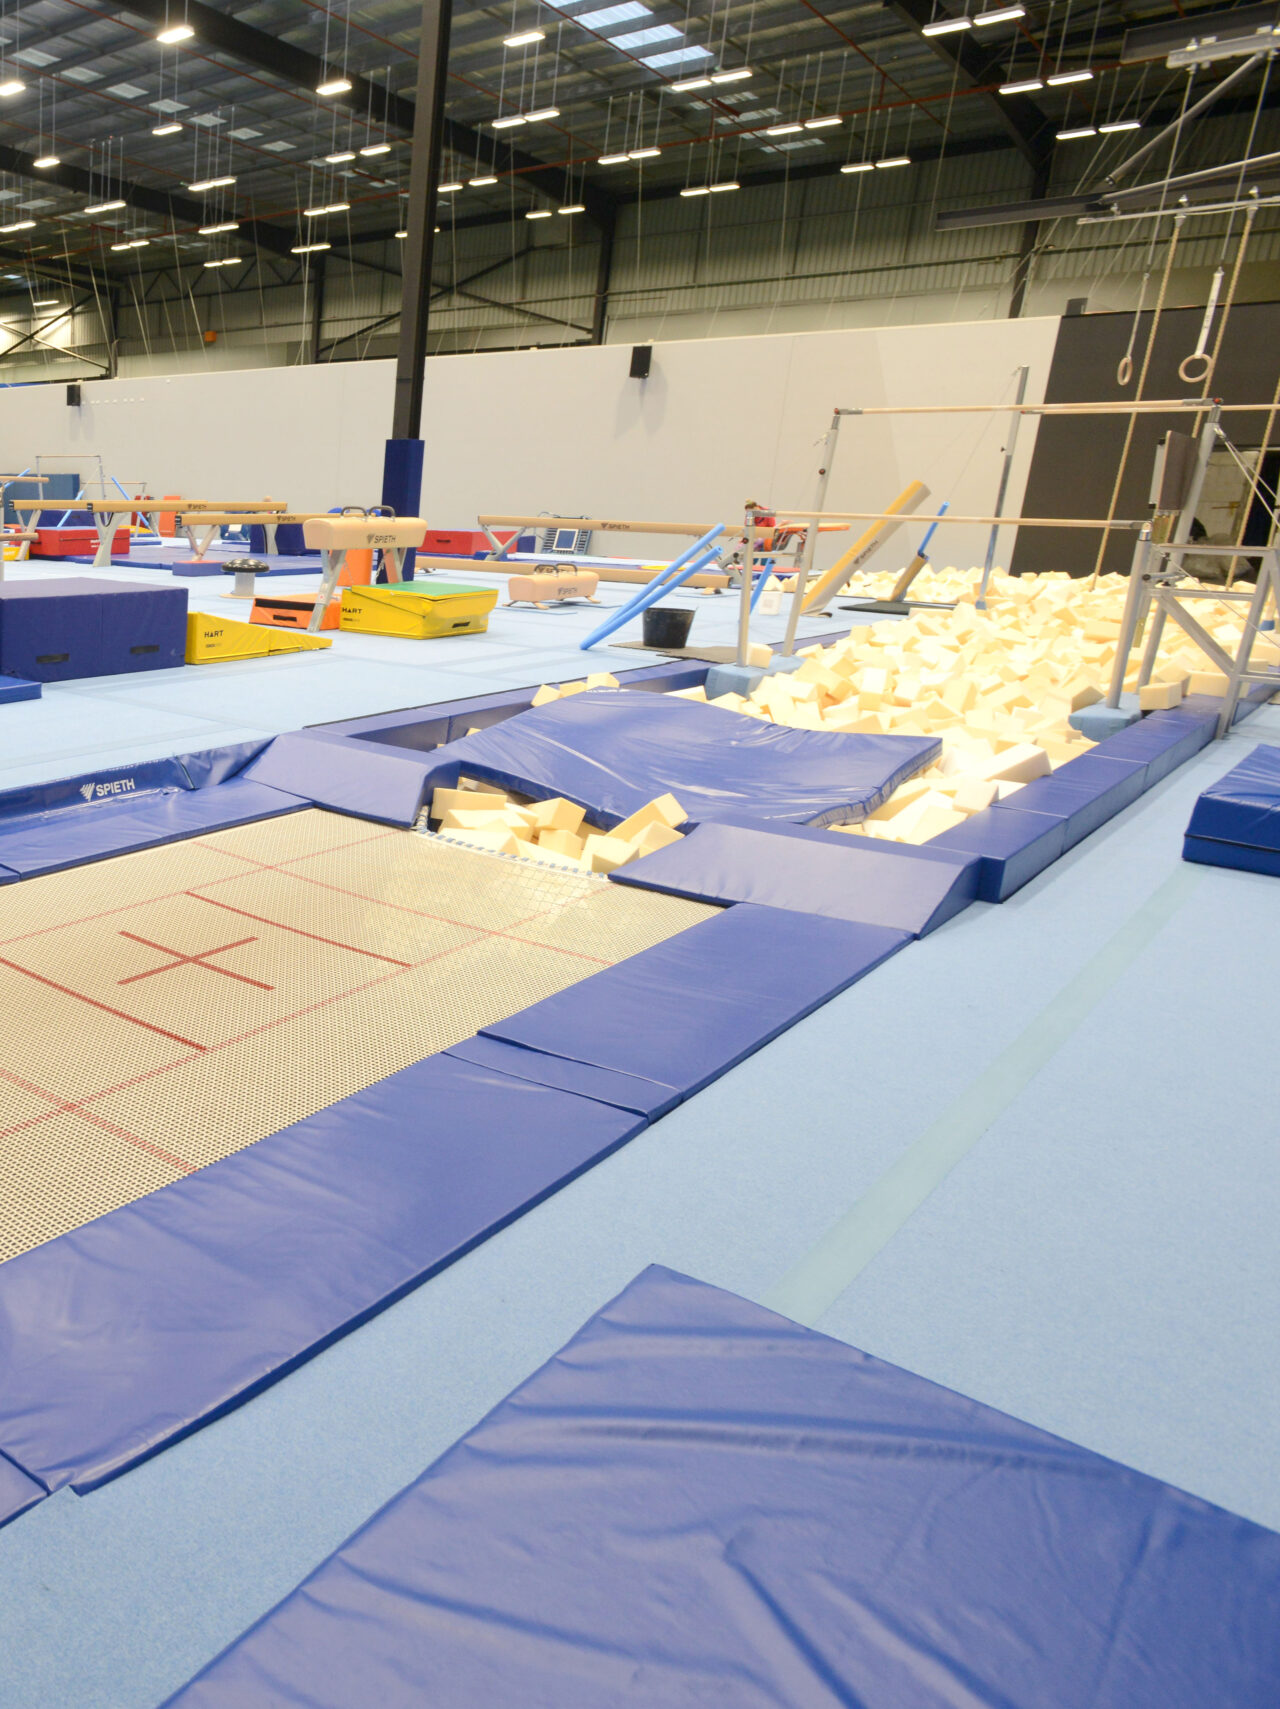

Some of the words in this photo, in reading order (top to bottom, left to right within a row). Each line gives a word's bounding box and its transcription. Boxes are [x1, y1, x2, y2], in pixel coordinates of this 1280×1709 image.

[373, 533, 397, 544] SPIETH
[204, 630, 223, 638] HART
[96, 778, 135, 797] SPIETH
